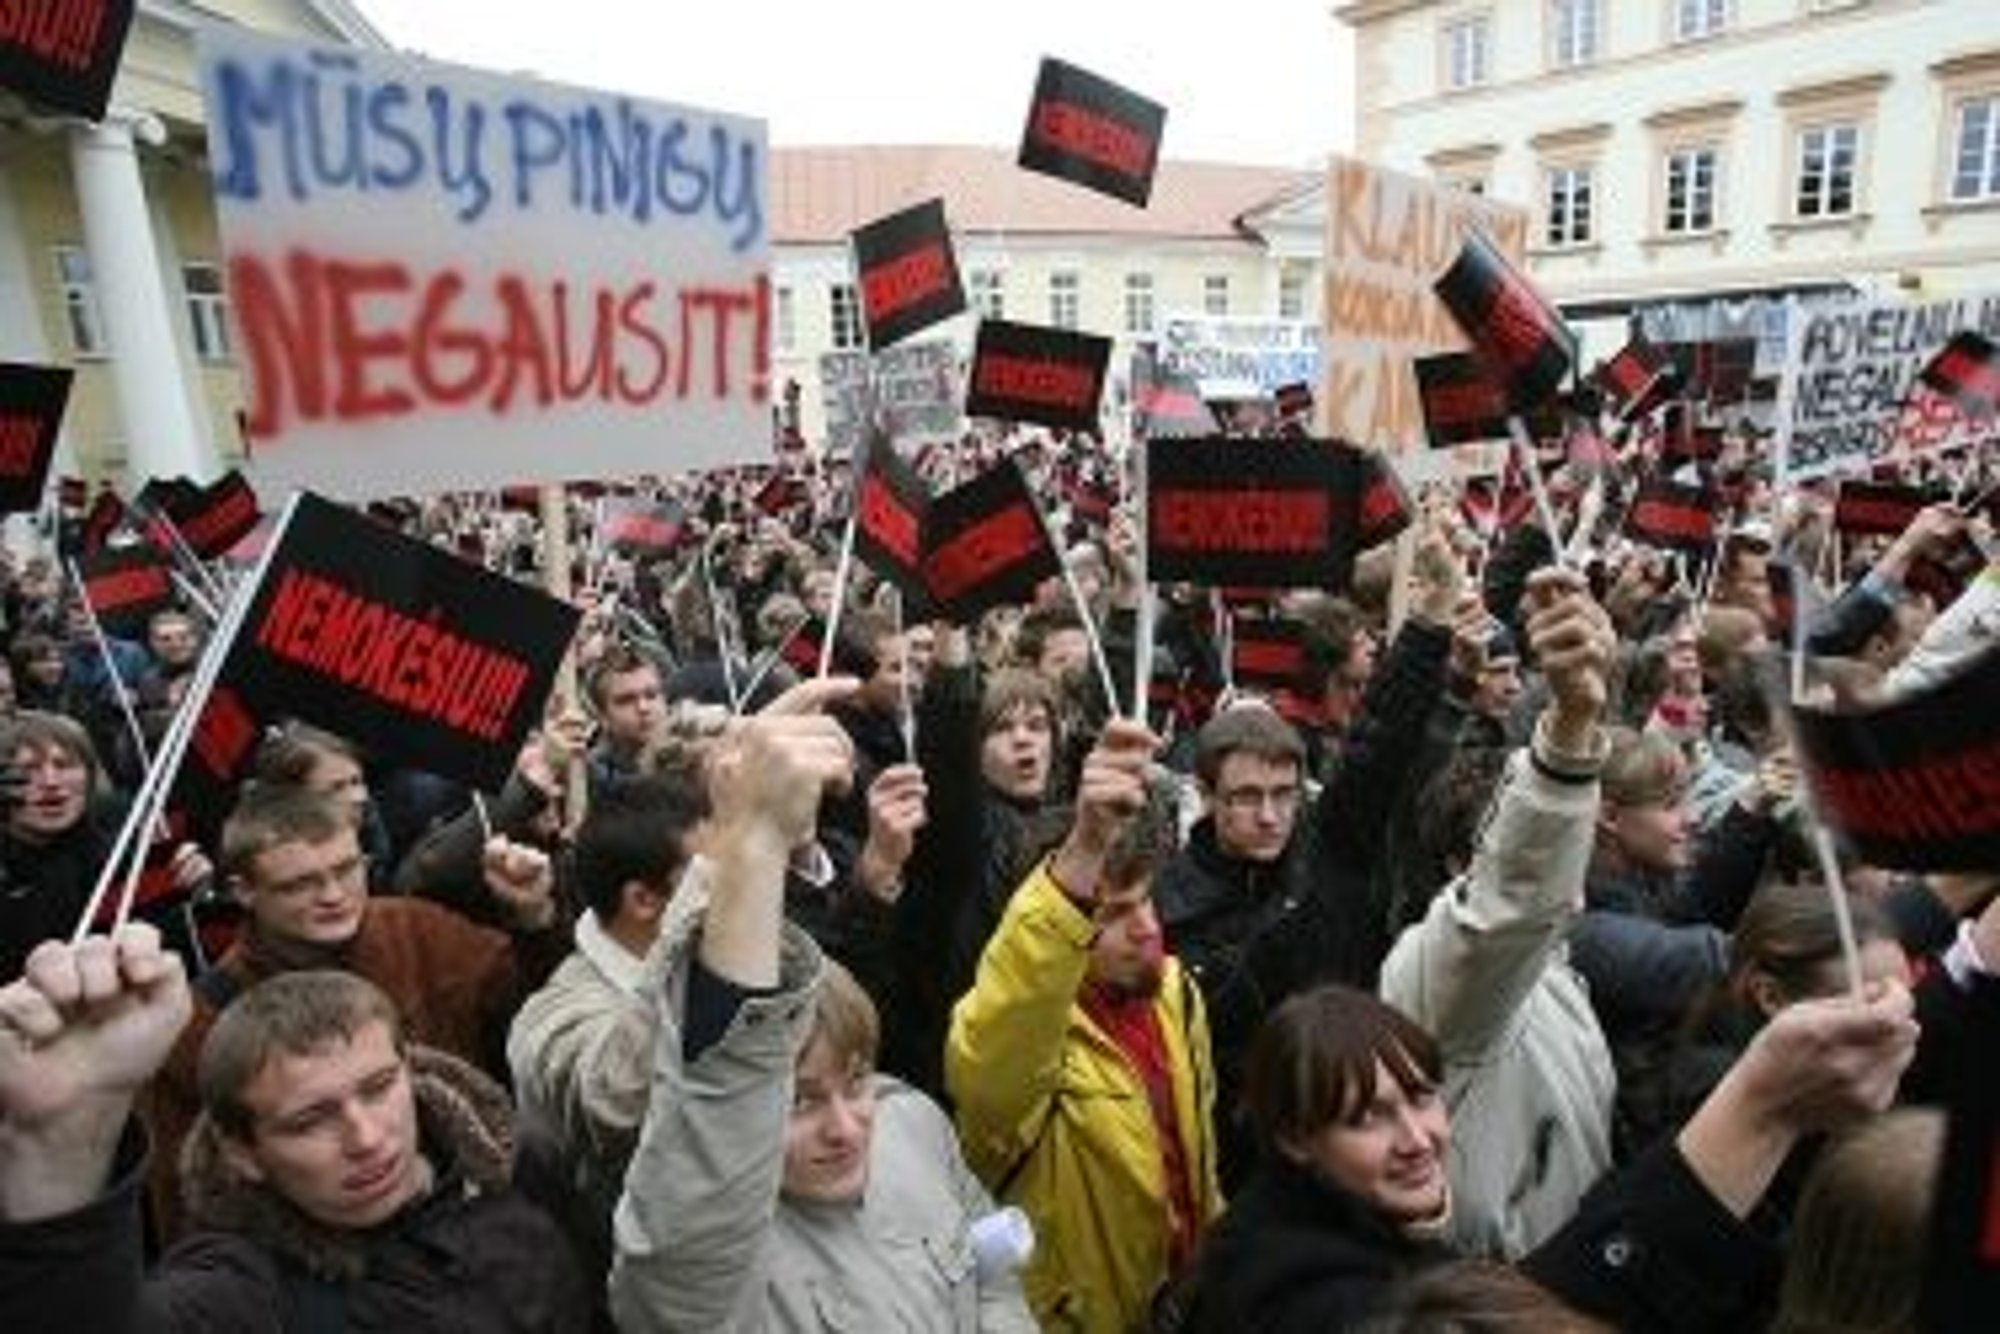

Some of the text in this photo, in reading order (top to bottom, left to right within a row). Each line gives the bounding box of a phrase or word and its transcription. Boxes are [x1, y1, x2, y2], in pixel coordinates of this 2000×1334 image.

[215, 52, 764, 250] MŪSŲ PINIGŲ
[228, 248, 772, 440] NEGAUSIT!
